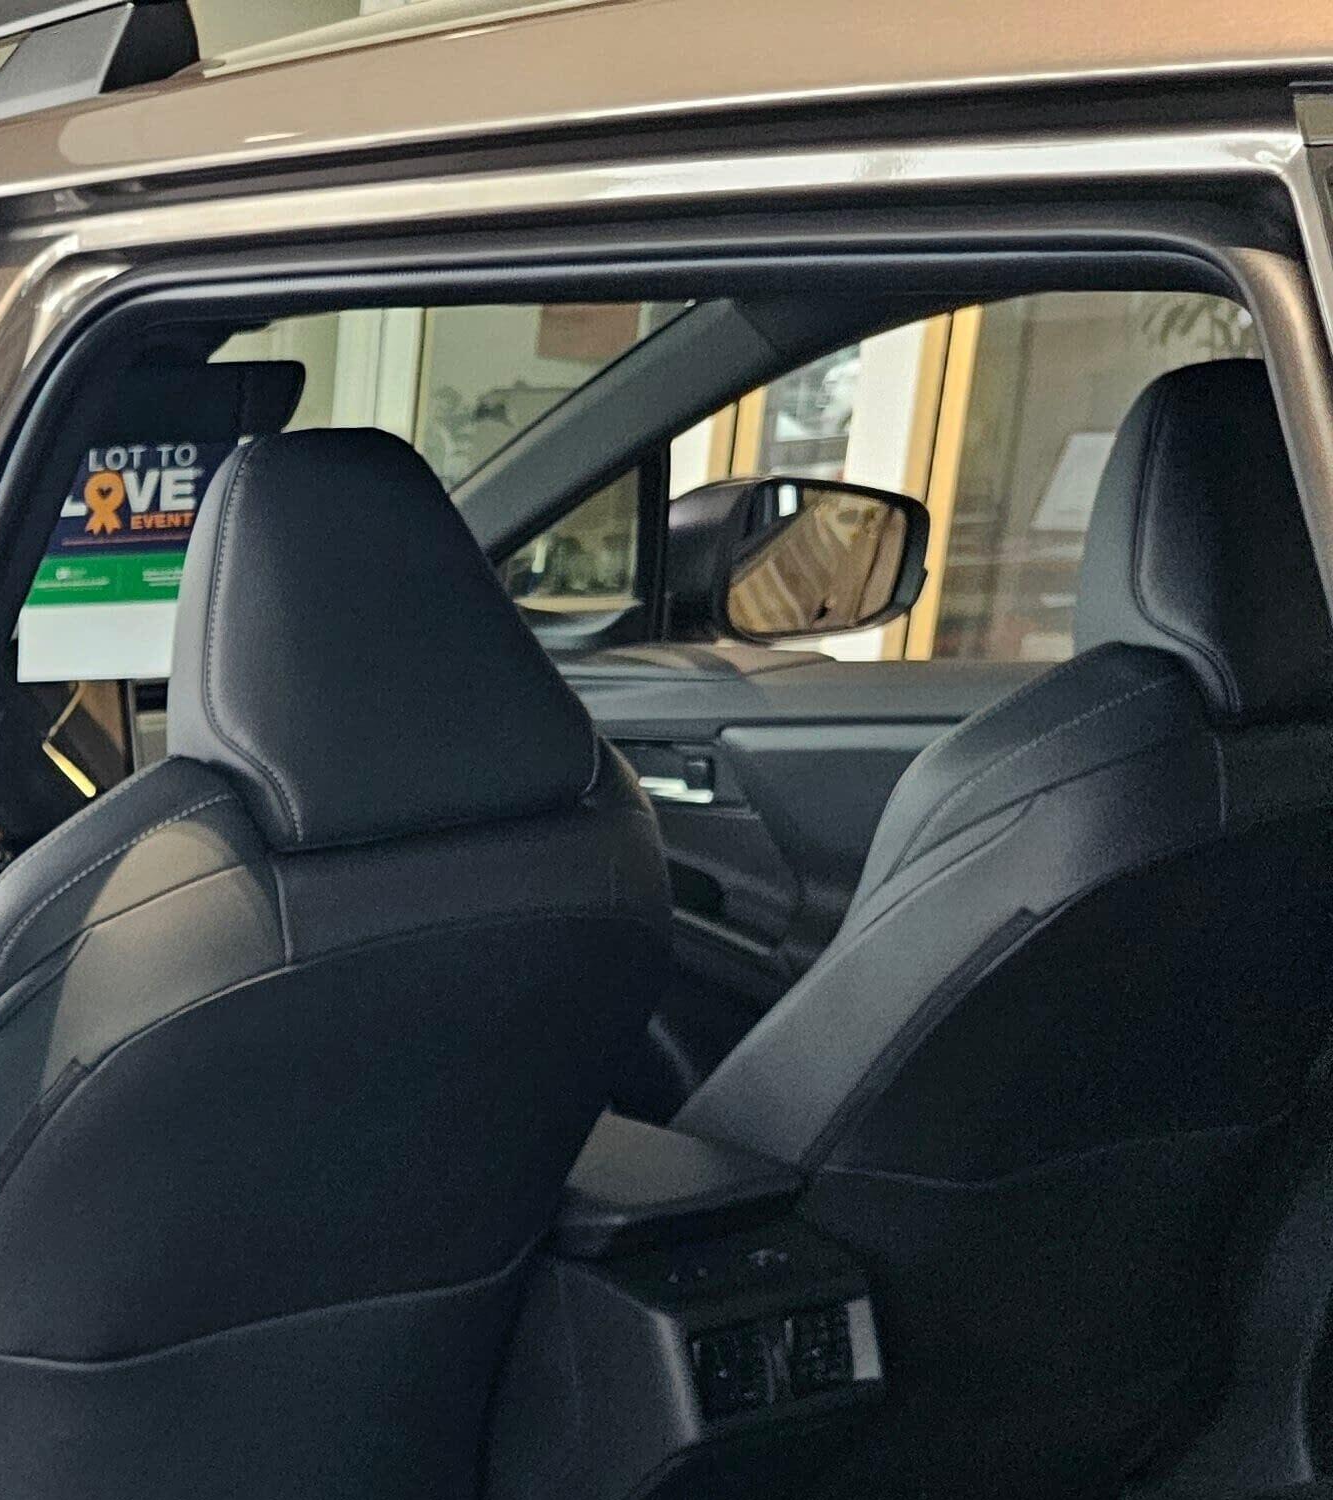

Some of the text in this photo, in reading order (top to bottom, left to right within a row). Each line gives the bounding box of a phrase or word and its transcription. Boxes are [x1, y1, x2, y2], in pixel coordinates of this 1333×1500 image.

[88, 443, 197, 472] LOT TO
[130, 512, 194, 530] EVENT
